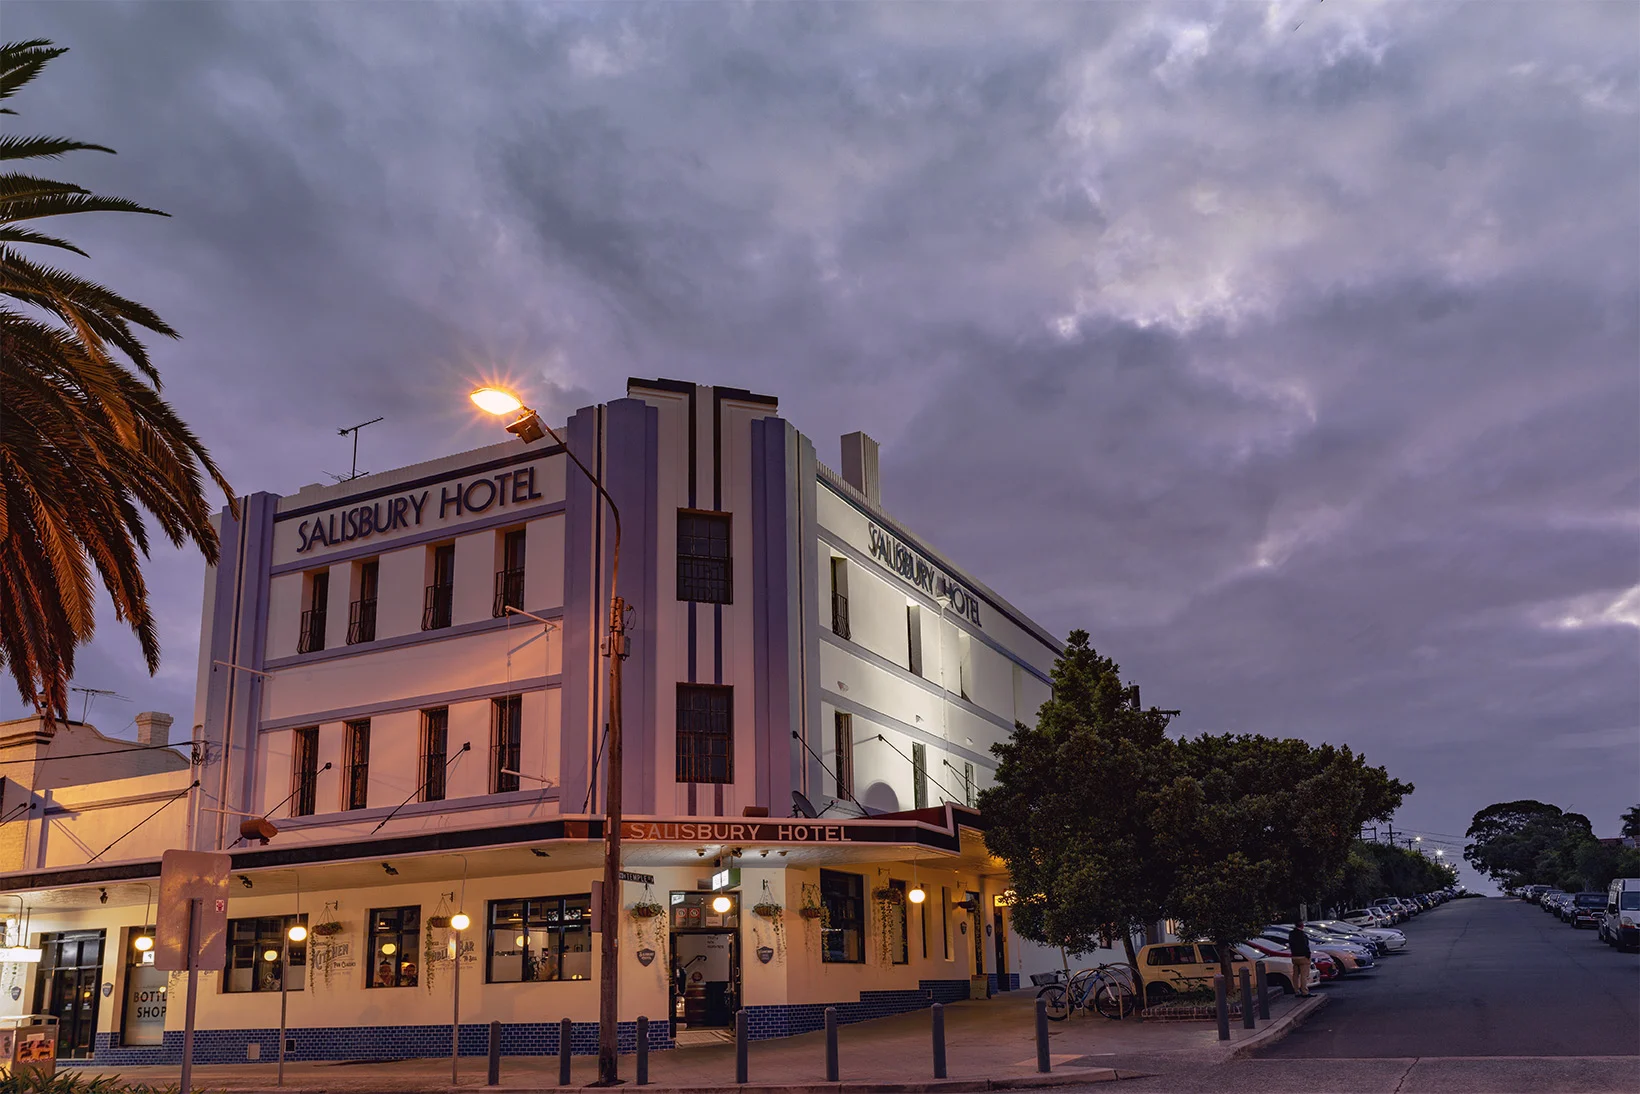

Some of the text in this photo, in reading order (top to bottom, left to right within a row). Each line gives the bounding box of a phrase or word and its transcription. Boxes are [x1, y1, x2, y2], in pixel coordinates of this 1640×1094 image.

[297, 466, 541, 552] SALISBURY HOTEL
[868, 521, 982, 628] SALISBURY HOTEL
[630, 823, 852, 841] SALISBURY HOTEL
[133, 990, 167, 1002] BOTTL
[137, 1006, 167, 1018] SHOP
